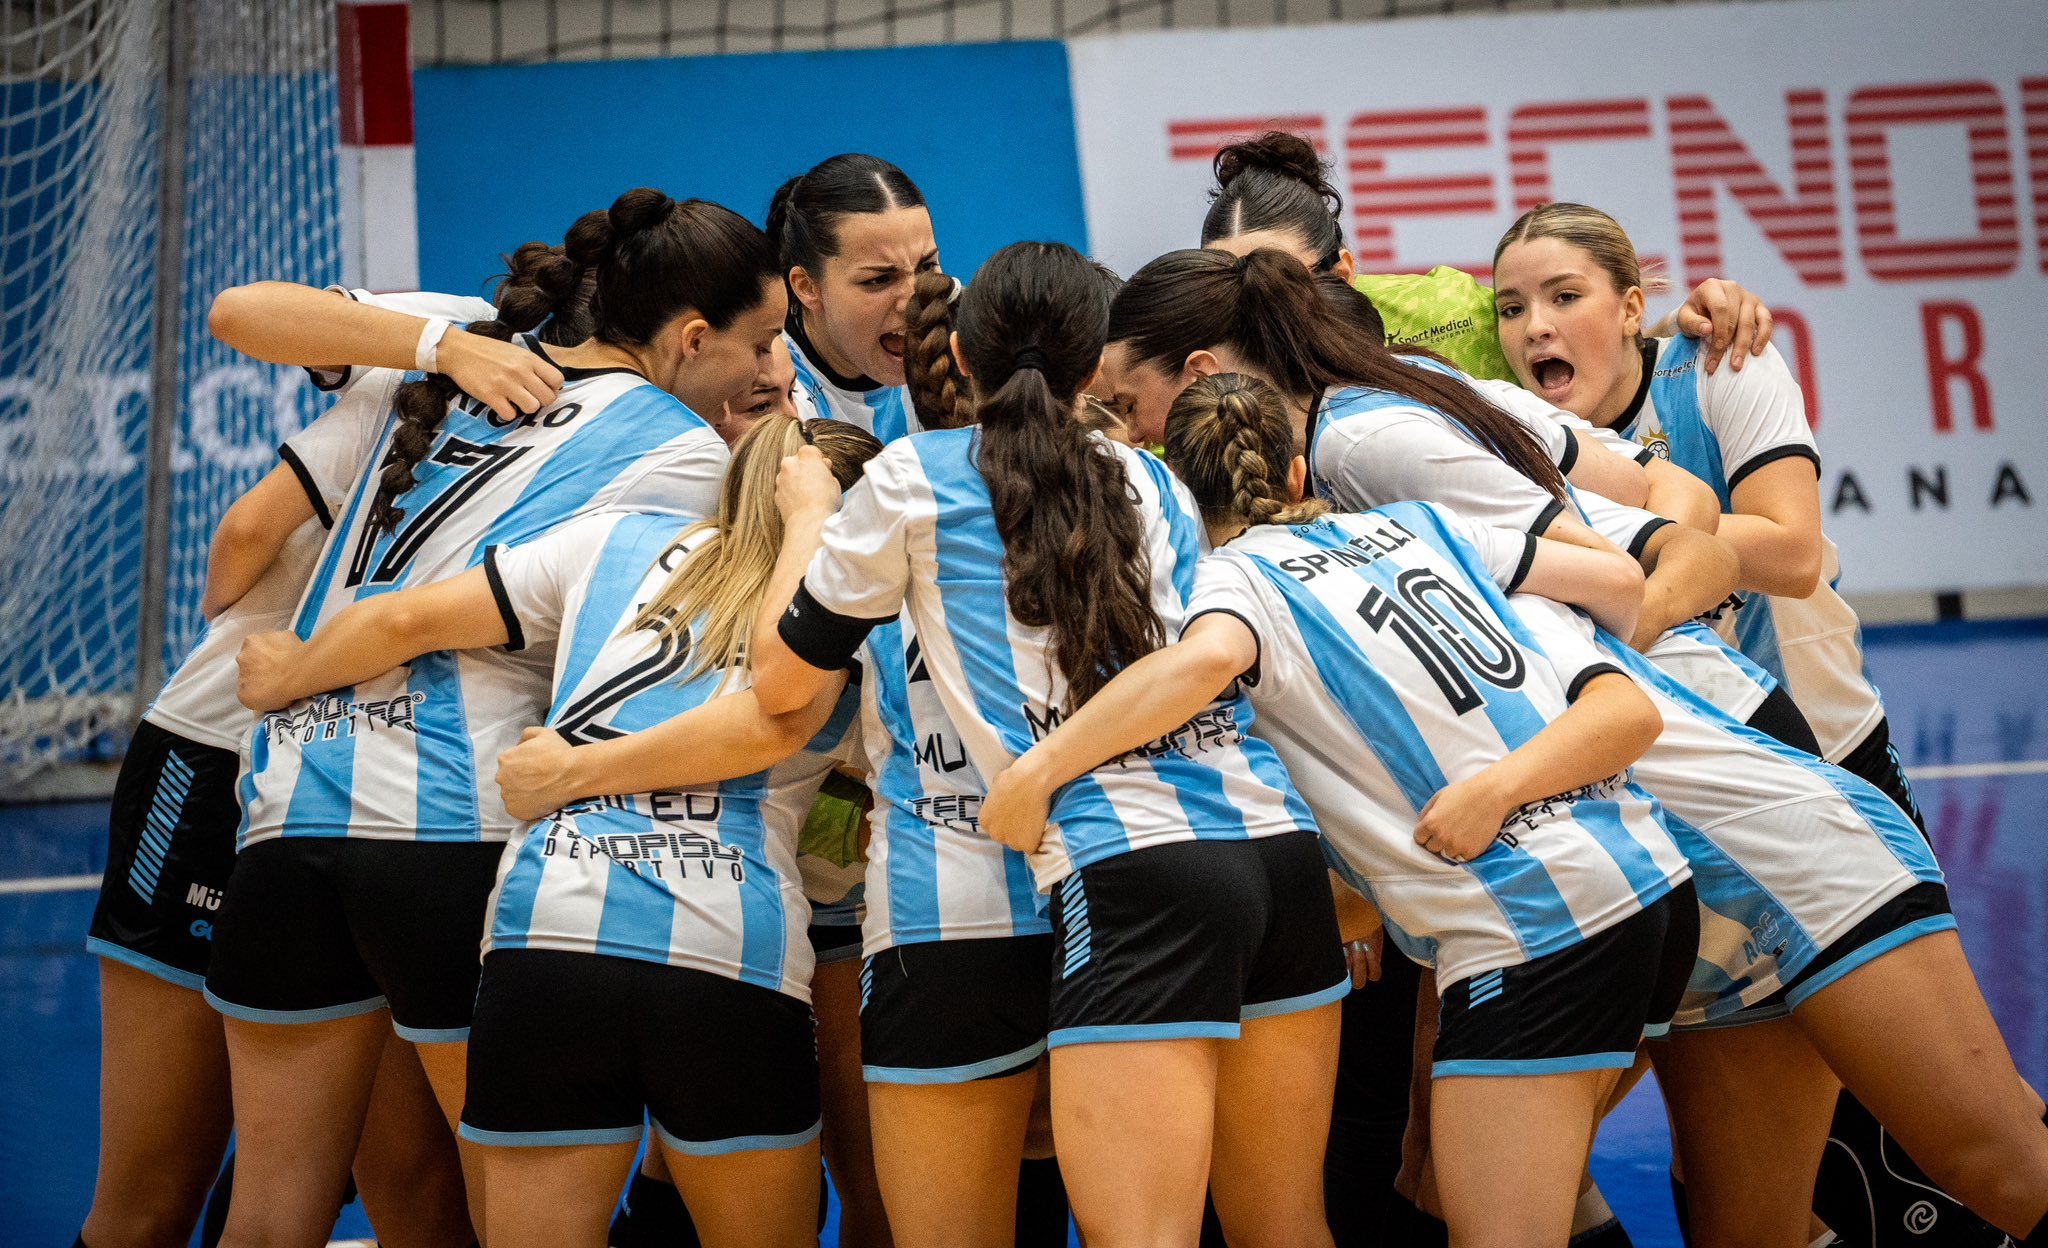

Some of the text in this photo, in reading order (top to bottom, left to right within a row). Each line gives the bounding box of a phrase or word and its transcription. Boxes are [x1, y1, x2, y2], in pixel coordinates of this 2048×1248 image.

[1168, 76, 2048, 296] TECNO
[1279, 518, 1417, 583] SPINELLI
[1355, 566, 1526, 717] 10
